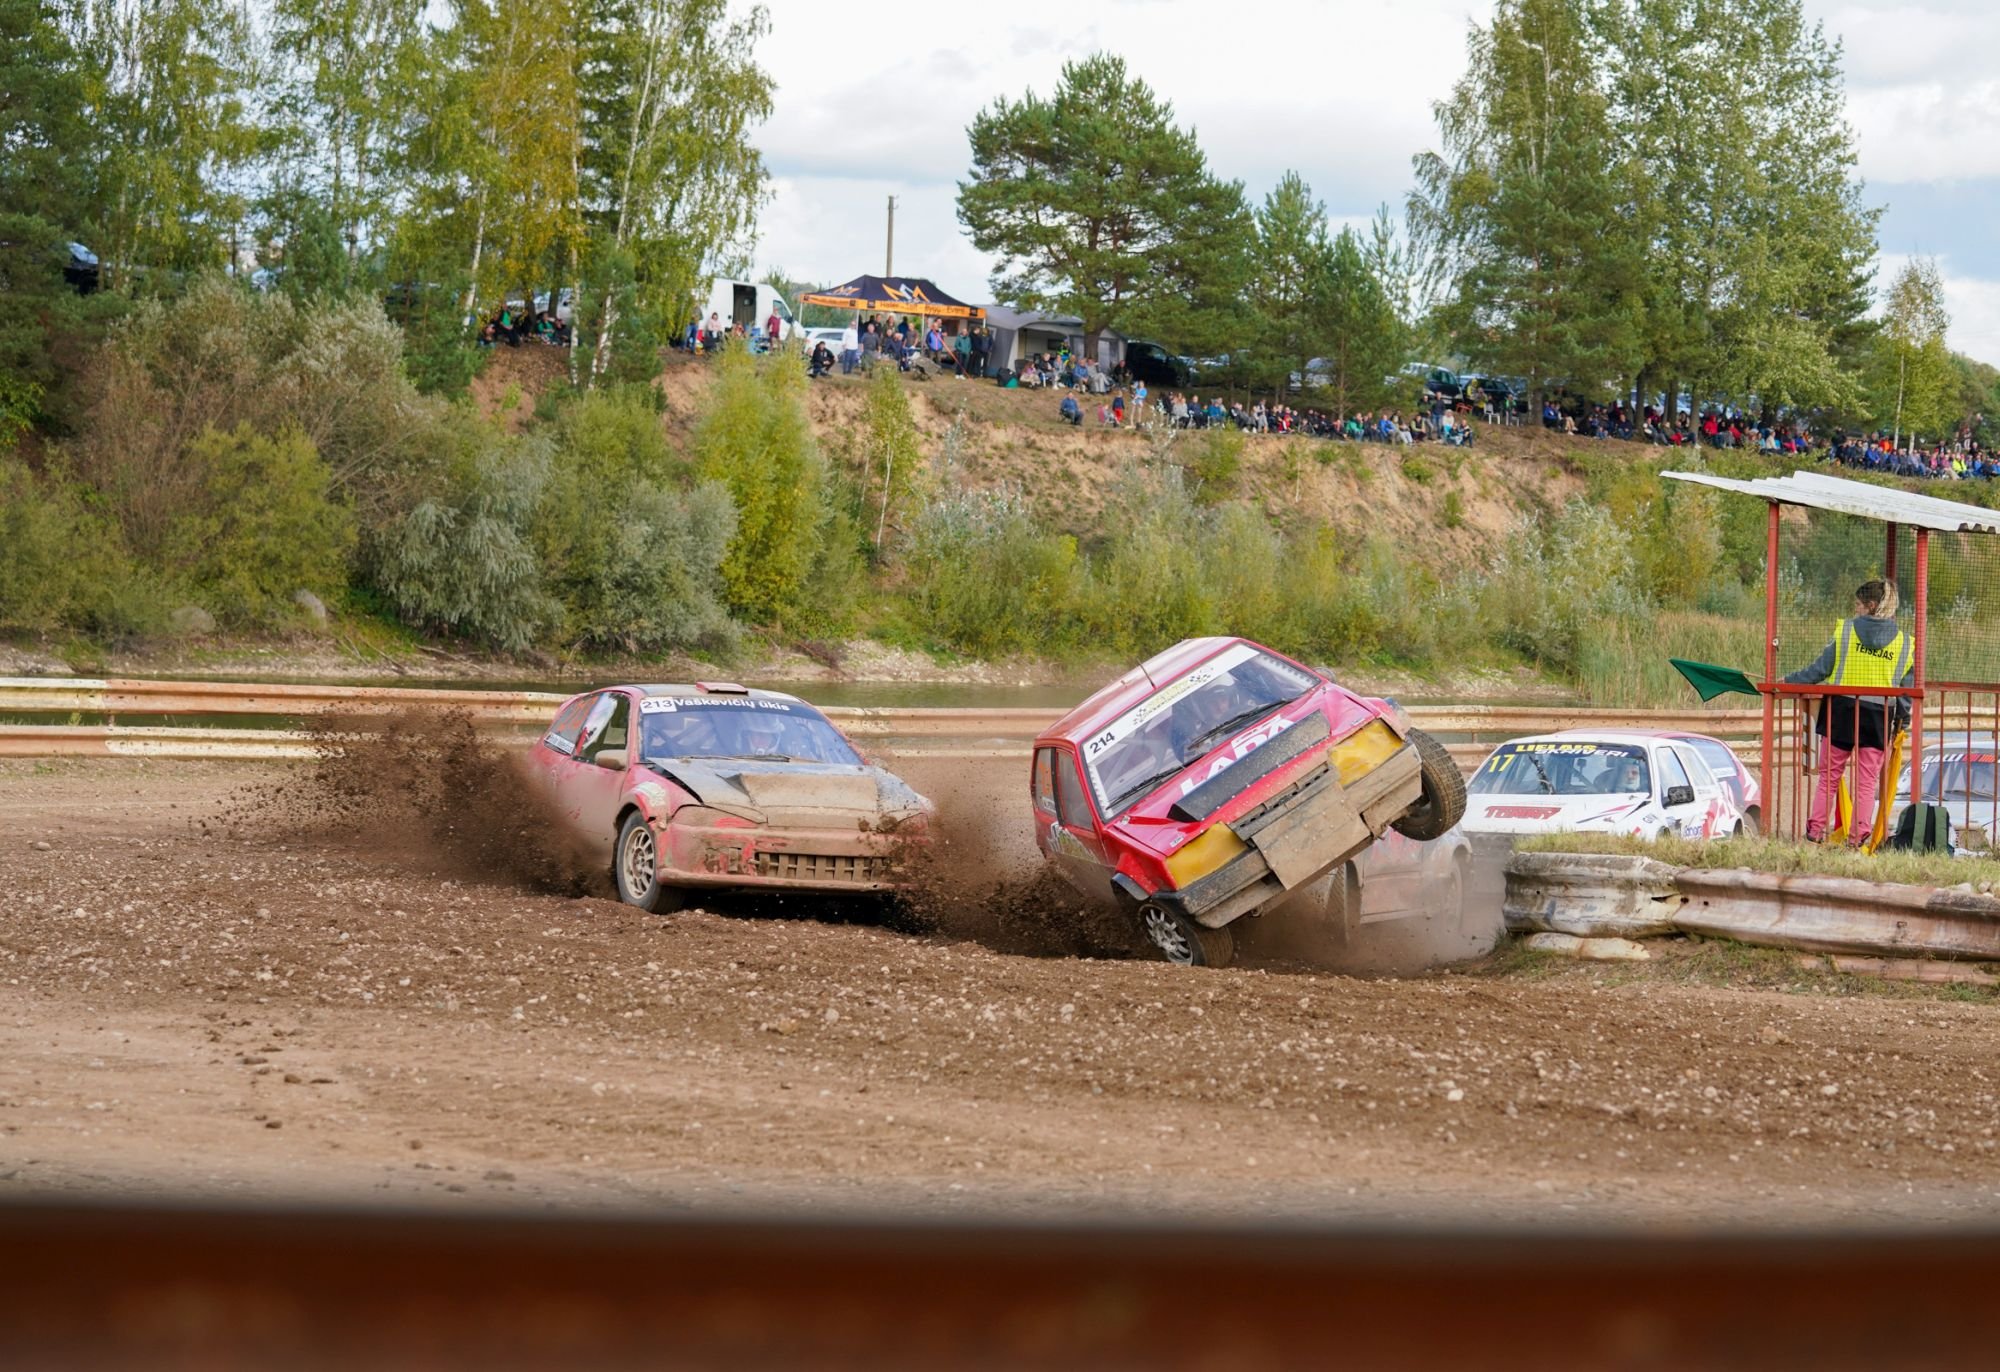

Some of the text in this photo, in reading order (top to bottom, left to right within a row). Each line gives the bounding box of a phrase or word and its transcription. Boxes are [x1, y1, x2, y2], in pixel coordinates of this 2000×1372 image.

[641, 700, 674, 709] 213
[1089, 731, 1116, 754] 214
[1489, 754, 1515, 773] 17
